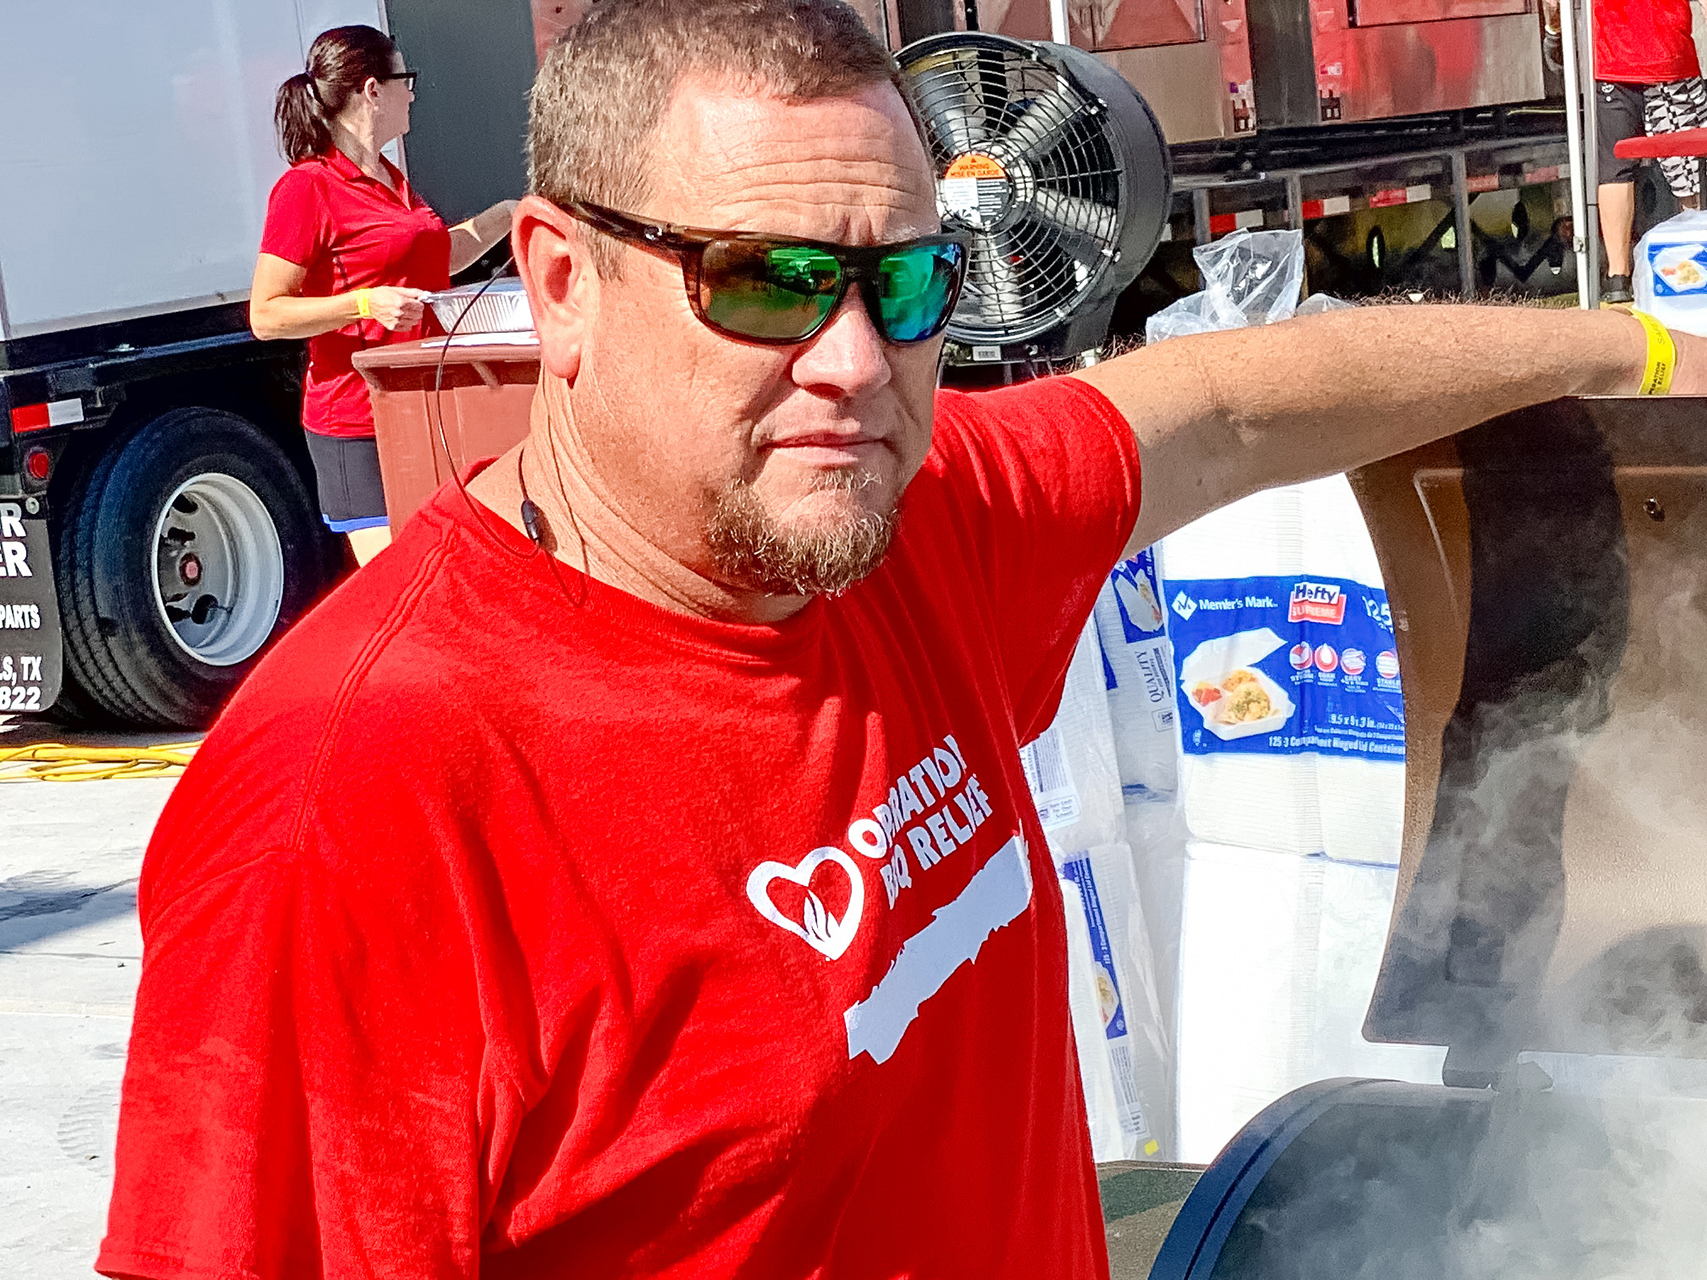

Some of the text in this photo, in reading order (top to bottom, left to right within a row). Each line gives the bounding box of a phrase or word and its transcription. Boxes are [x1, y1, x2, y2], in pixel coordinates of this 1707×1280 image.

[1245, 595, 1274, 608] Mark
[1295, 584, 1337, 603] Hefty
[0, 604, 41, 629] PARTS
[20, 656, 42, 681] TX
[1134, 651, 1164, 703] QUALITY
[0, 686, 41, 710] 822
[848, 734, 967, 858] OPRATIO
[879, 773, 993, 910] BQ RELIEF
